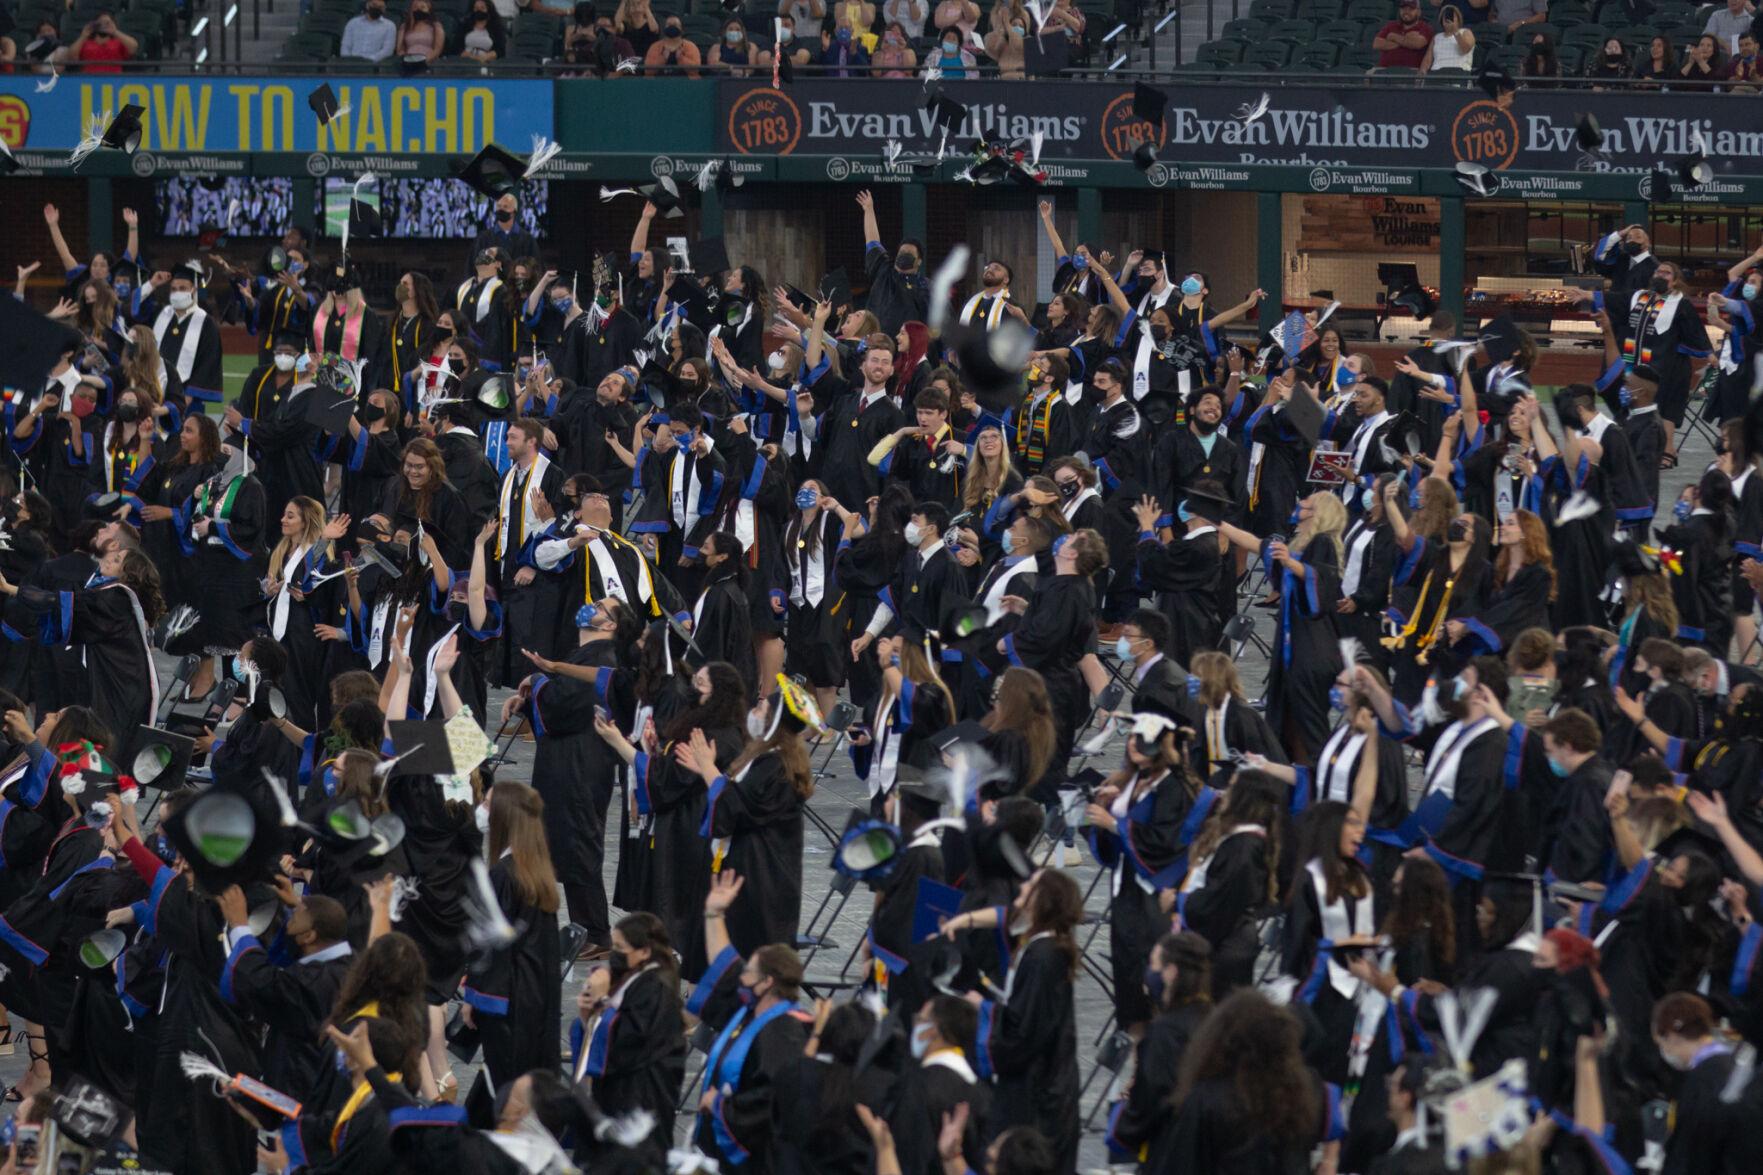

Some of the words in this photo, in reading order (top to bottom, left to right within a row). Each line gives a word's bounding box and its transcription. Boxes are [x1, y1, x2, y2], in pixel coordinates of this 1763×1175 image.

[746, 99, 778, 116] SINCE
[1116, 104, 1134, 121] SIN
[80, 84, 213, 151] HOW
[229, 85, 294, 152] TO
[316, 86, 495, 153] NACHO
[807, 102, 916, 138] Evan
[1467, 112, 1498, 128] SINCE
[741, 116, 789, 147] 1783
[1172, 107, 1270, 145] Evan
[1267, 109, 1430, 149] Williams
[1525, 114, 1626, 152] Evn
[1624, 117, 1763, 156] William
[1463, 129, 1507, 160] 1783
[157, 156, 189, 170] Evan
[189, 157, 243, 170] Williams
[331, 157, 364, 170] Evan
[364, 157, 418, 170] Williams
[851, 161, 882, 173] Evan
[1170, 168, 1199, 180] Evan
[1199, 168, 1249, 181] Williams
[1331, 171, 1361, 184] Evan
[1361, 172, 1412, 185] Williams
[1190, 181, 1224, 189] Bourbon
[1353, 185, 1387, 193] Bourbon
[1500, 177, 1531, 189] Evan
[1531, 177, 1582, 190] Williams
[1521, 190, 1556, 198] Bourbon
[1683, 194, 1719, 202] Bourbon
[1384, 198, 1426, 214] Evan
[1371, 215, 1440, 233] Williams
[1384, 235, 1431, 246] LOUNGE
